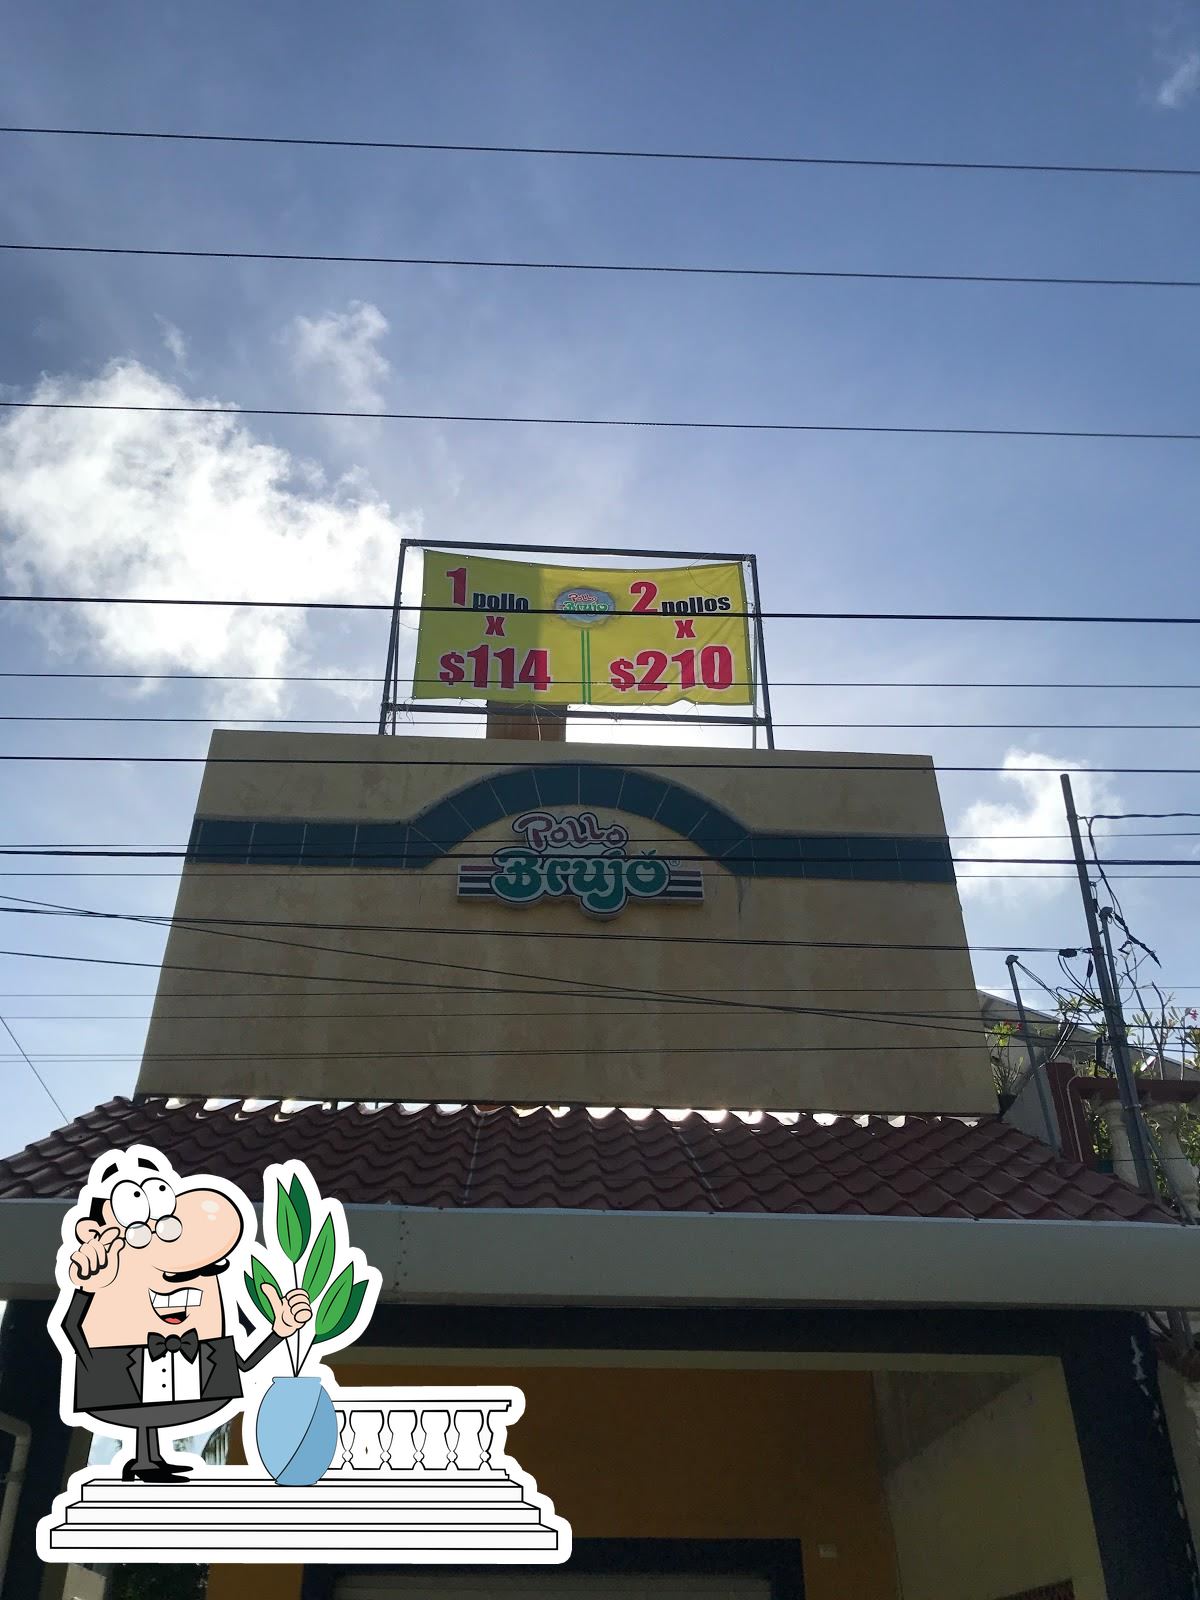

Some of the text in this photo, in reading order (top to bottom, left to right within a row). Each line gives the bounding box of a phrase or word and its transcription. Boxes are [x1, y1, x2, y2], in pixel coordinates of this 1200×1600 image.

[447, 568, 529, 613] 1 pollo
[630, 581, 730, 615] 2 pollos
[439, 644, 551, 691] $114
[610, 645, 733, 691] $210
